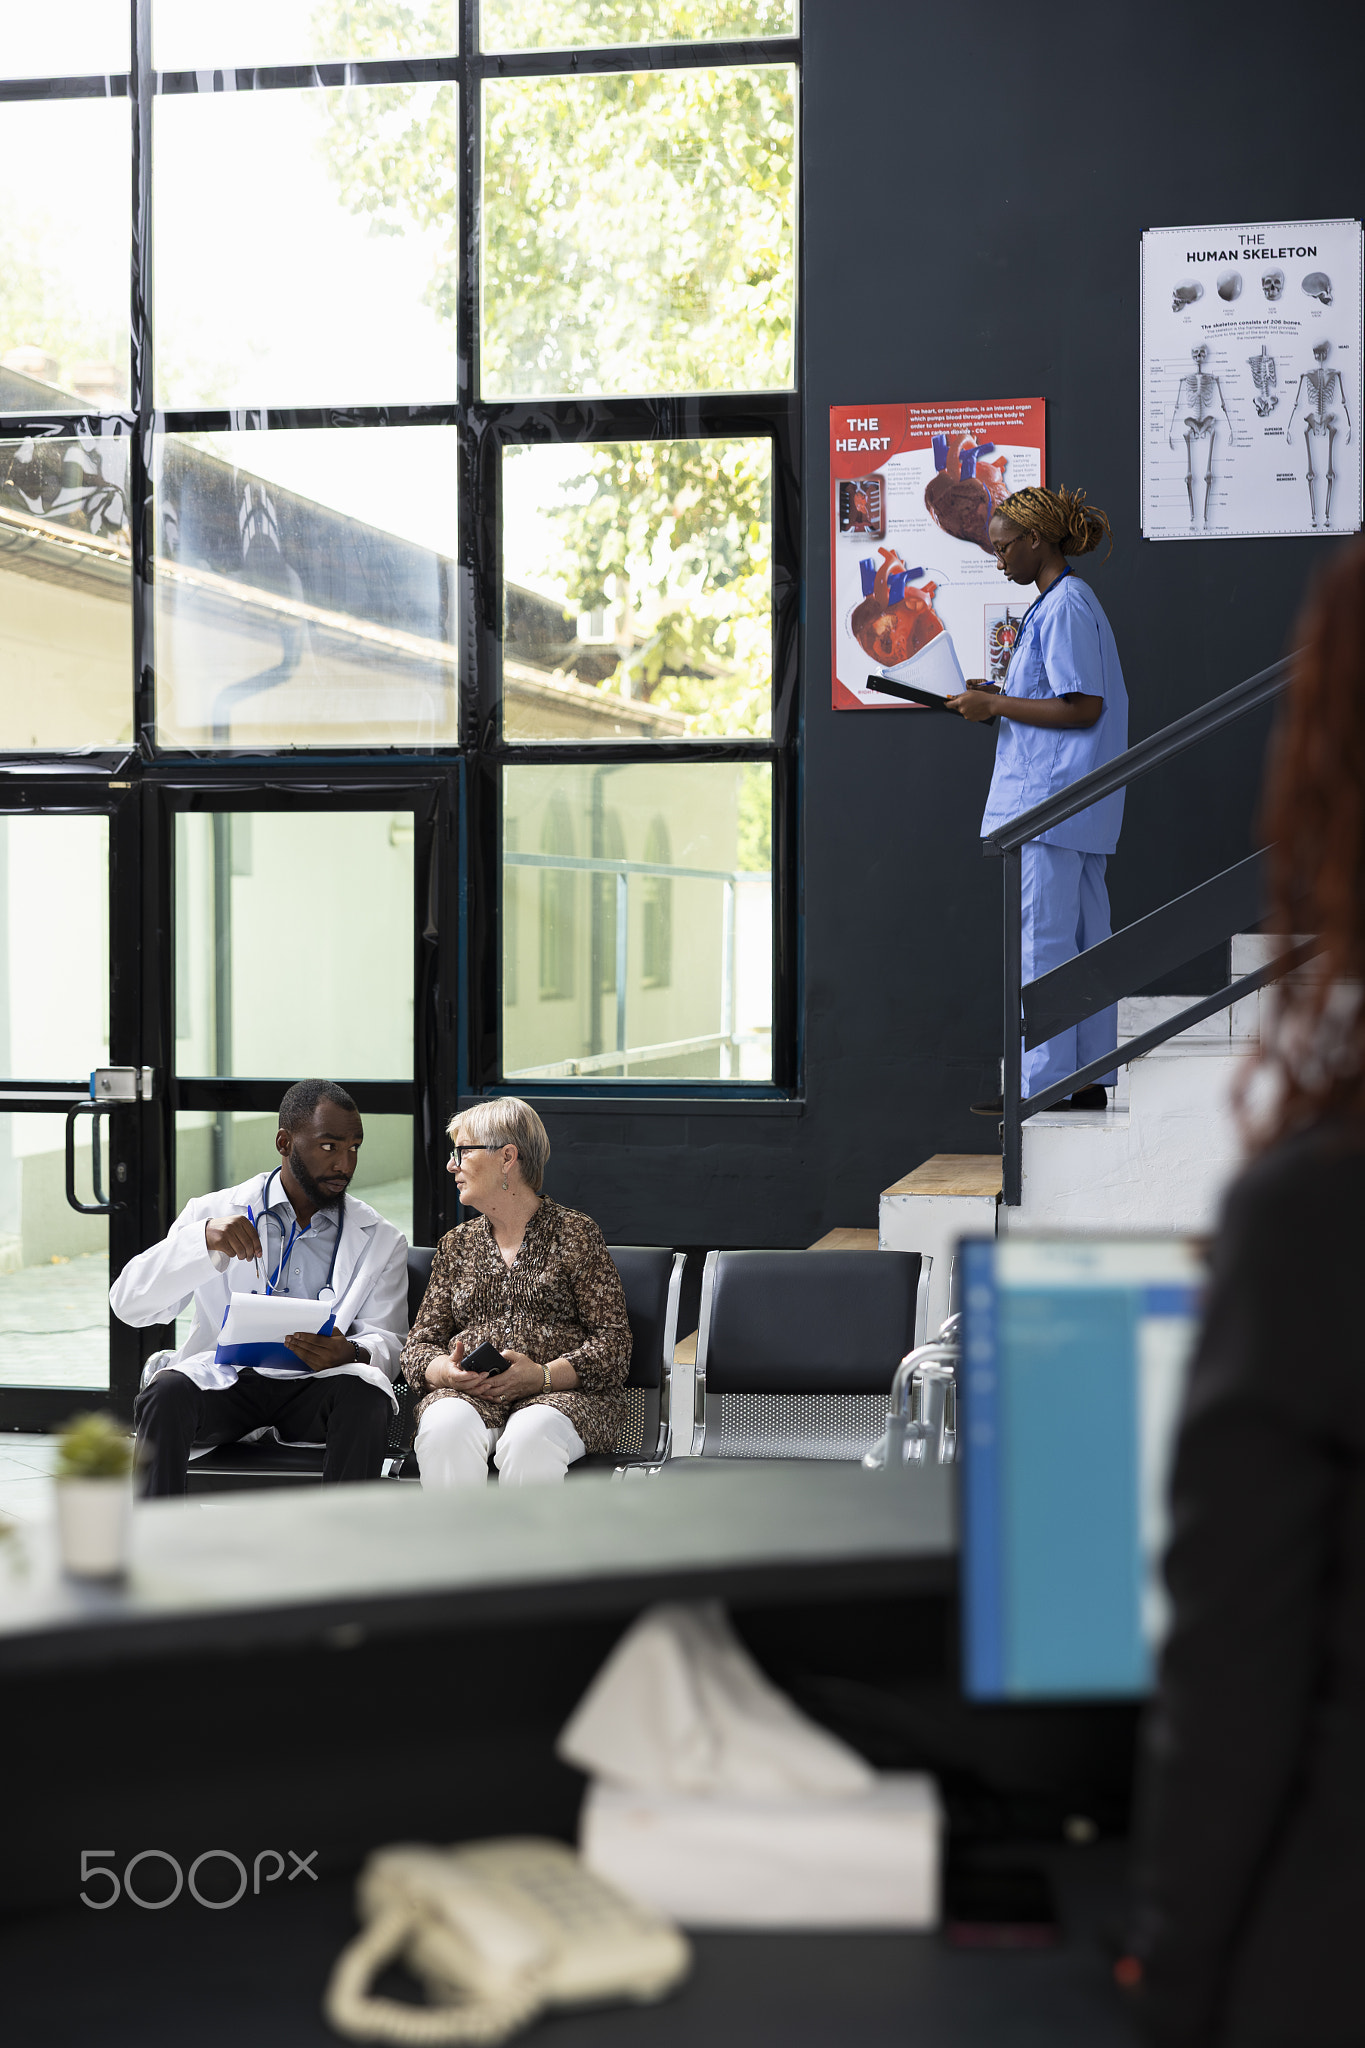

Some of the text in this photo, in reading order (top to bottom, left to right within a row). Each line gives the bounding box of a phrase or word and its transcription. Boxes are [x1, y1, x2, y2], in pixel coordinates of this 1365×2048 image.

[1238, 234, 1265, 245] THE
[1187, 246, 1317, 262] HUMAN SKELETON
[846, 418, 878, 431] THE
[836, 438, 890, 452] HEART
